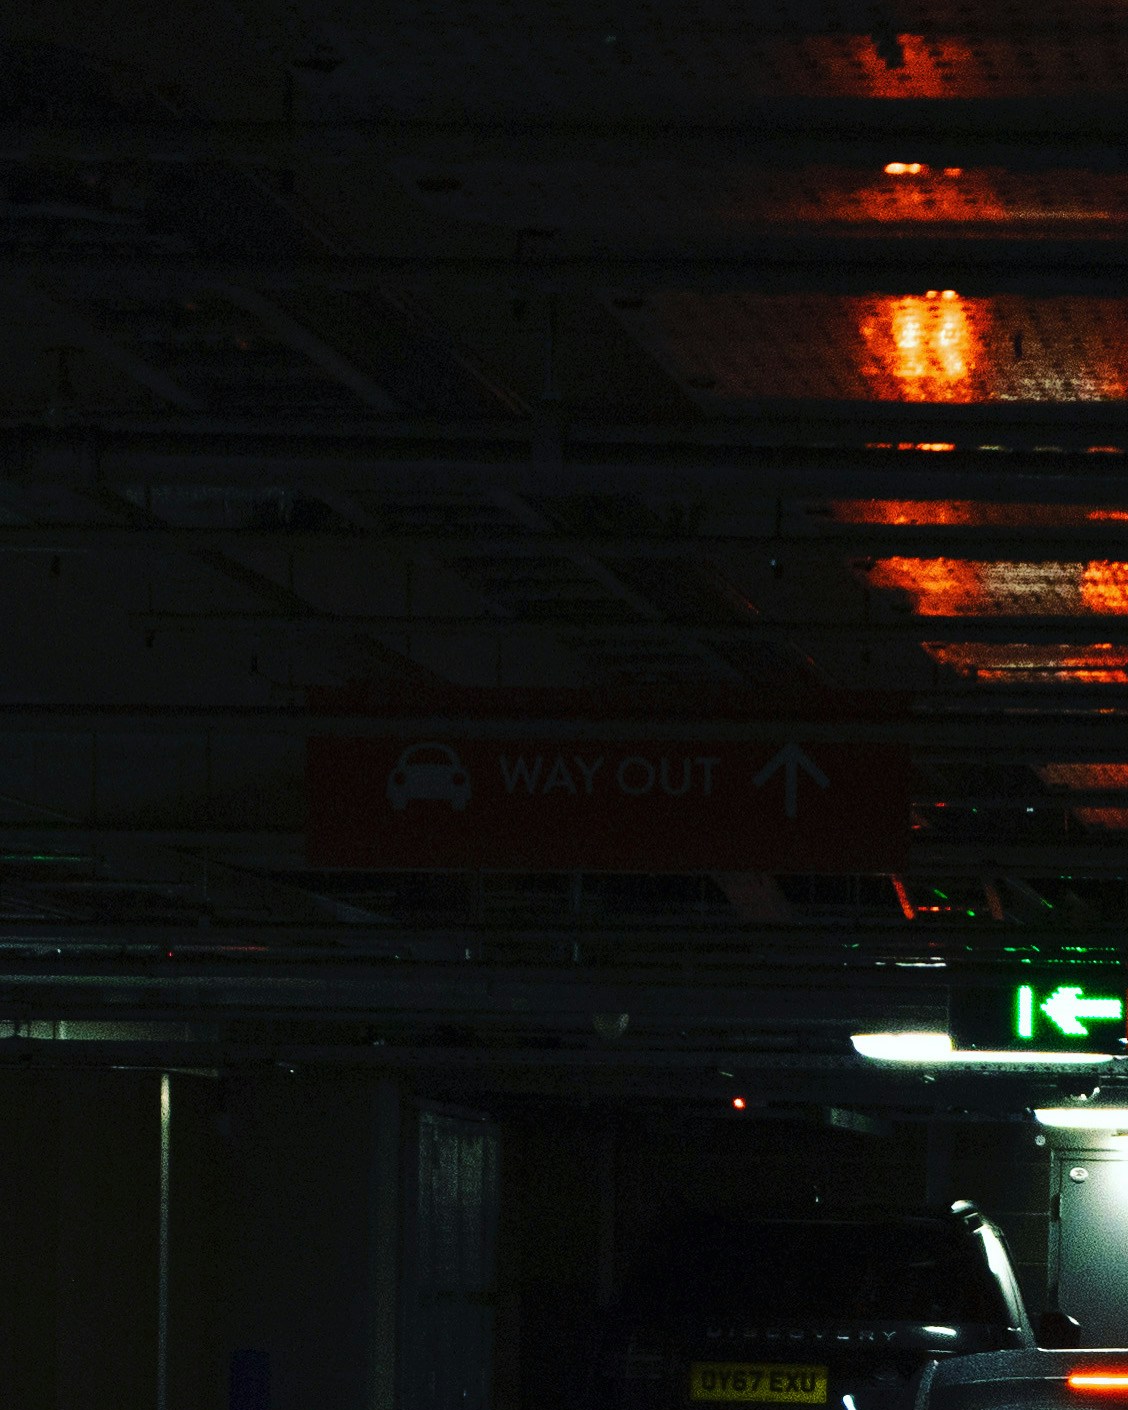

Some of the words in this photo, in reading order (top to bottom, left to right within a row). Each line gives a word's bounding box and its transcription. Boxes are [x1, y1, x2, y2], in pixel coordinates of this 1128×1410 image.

[499, 754, 604, 795] WAY
[615, 754, 721, 796] OUT
[769, 1370, 817, 1393] EXU
